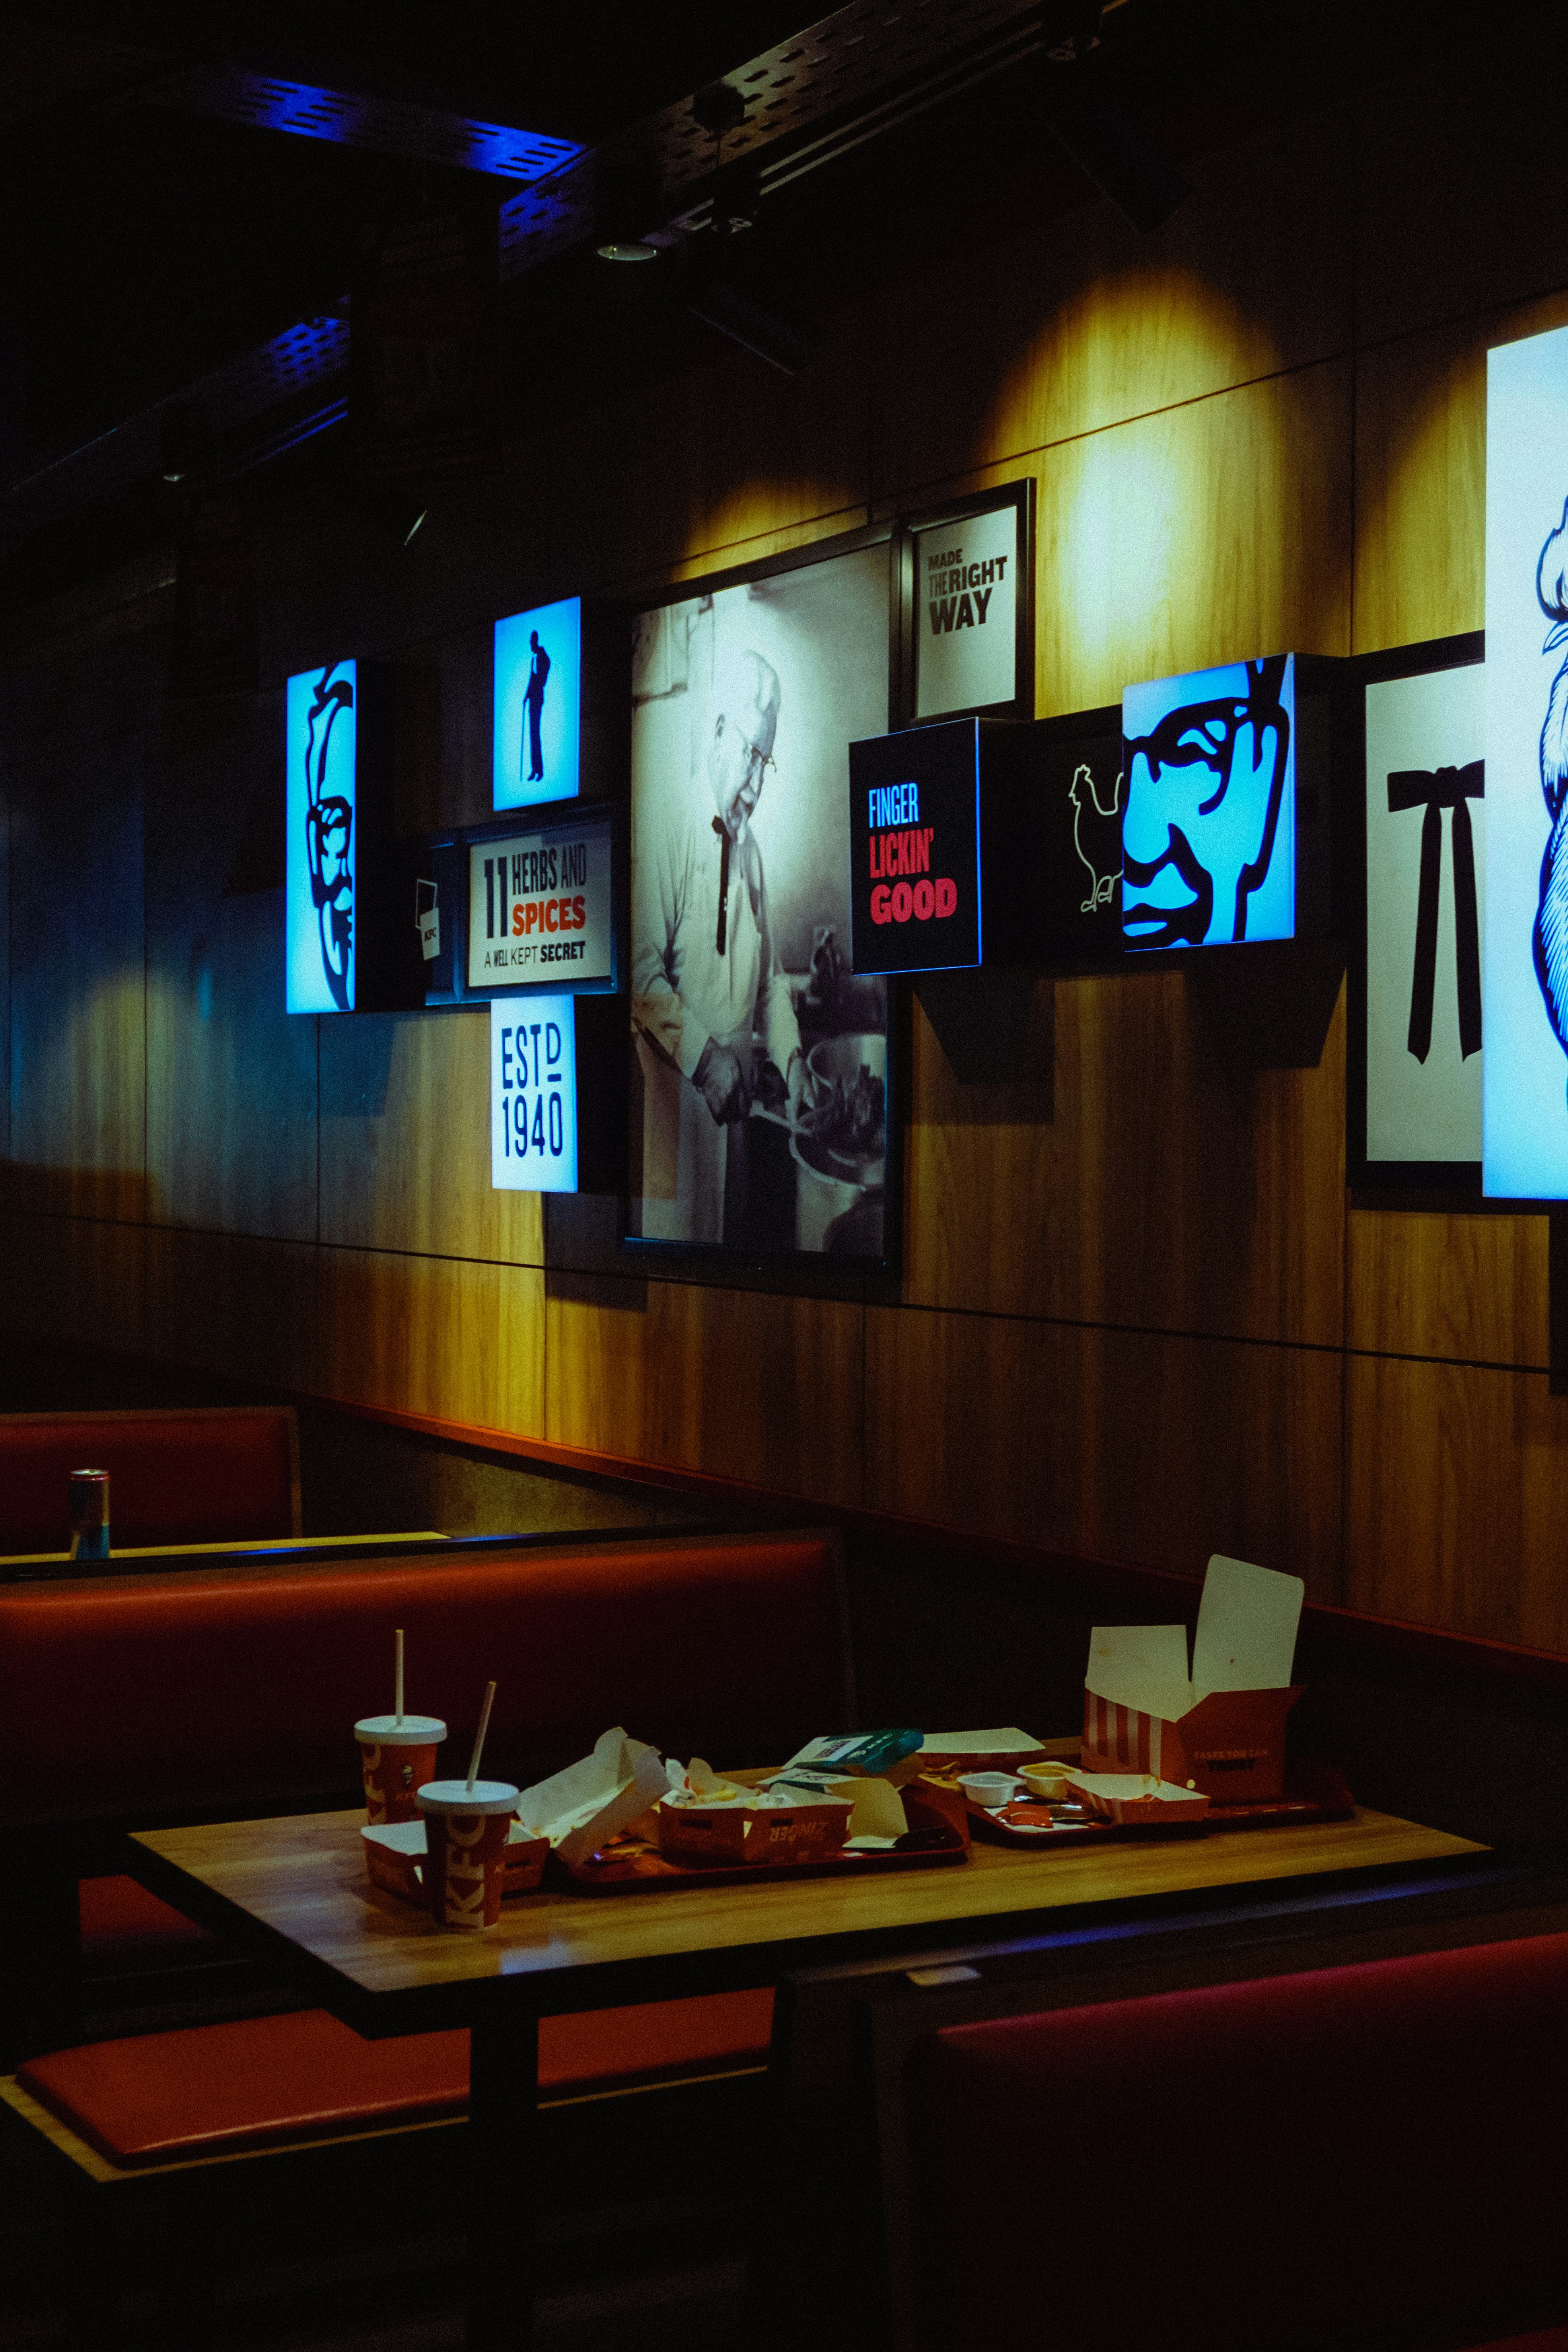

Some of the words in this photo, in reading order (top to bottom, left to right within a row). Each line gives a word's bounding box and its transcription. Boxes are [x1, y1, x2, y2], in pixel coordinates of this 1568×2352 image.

[928, 548, 963, 570] MADE
[929, 571, 947, 597] THE
[949, 555, 1007, 593] RIGHT
[929, 587, 992, 635] WAY
[868, 782, 919, 828] FINGER
[869, 827, 934, 879] LICKIN'
[484, 856, 508, 939] 11
[512, 848, 557, 895] HERBS
[561, 843, 586, 888] AND
[870, 877, 958, 925] GOOD
[424, 927, 437, 942] KFC
[512, 895, 586, 937] SPICES
[484, 951, 491, 968] A
[494, 949, 509, 967] WELL
[511, 946, 538, 966] KEPT
[540, 941, 586, 963] SECRET
[502, 1022, 562, 1089] ESTD
[502, 1092, 562, 1158] 1940
